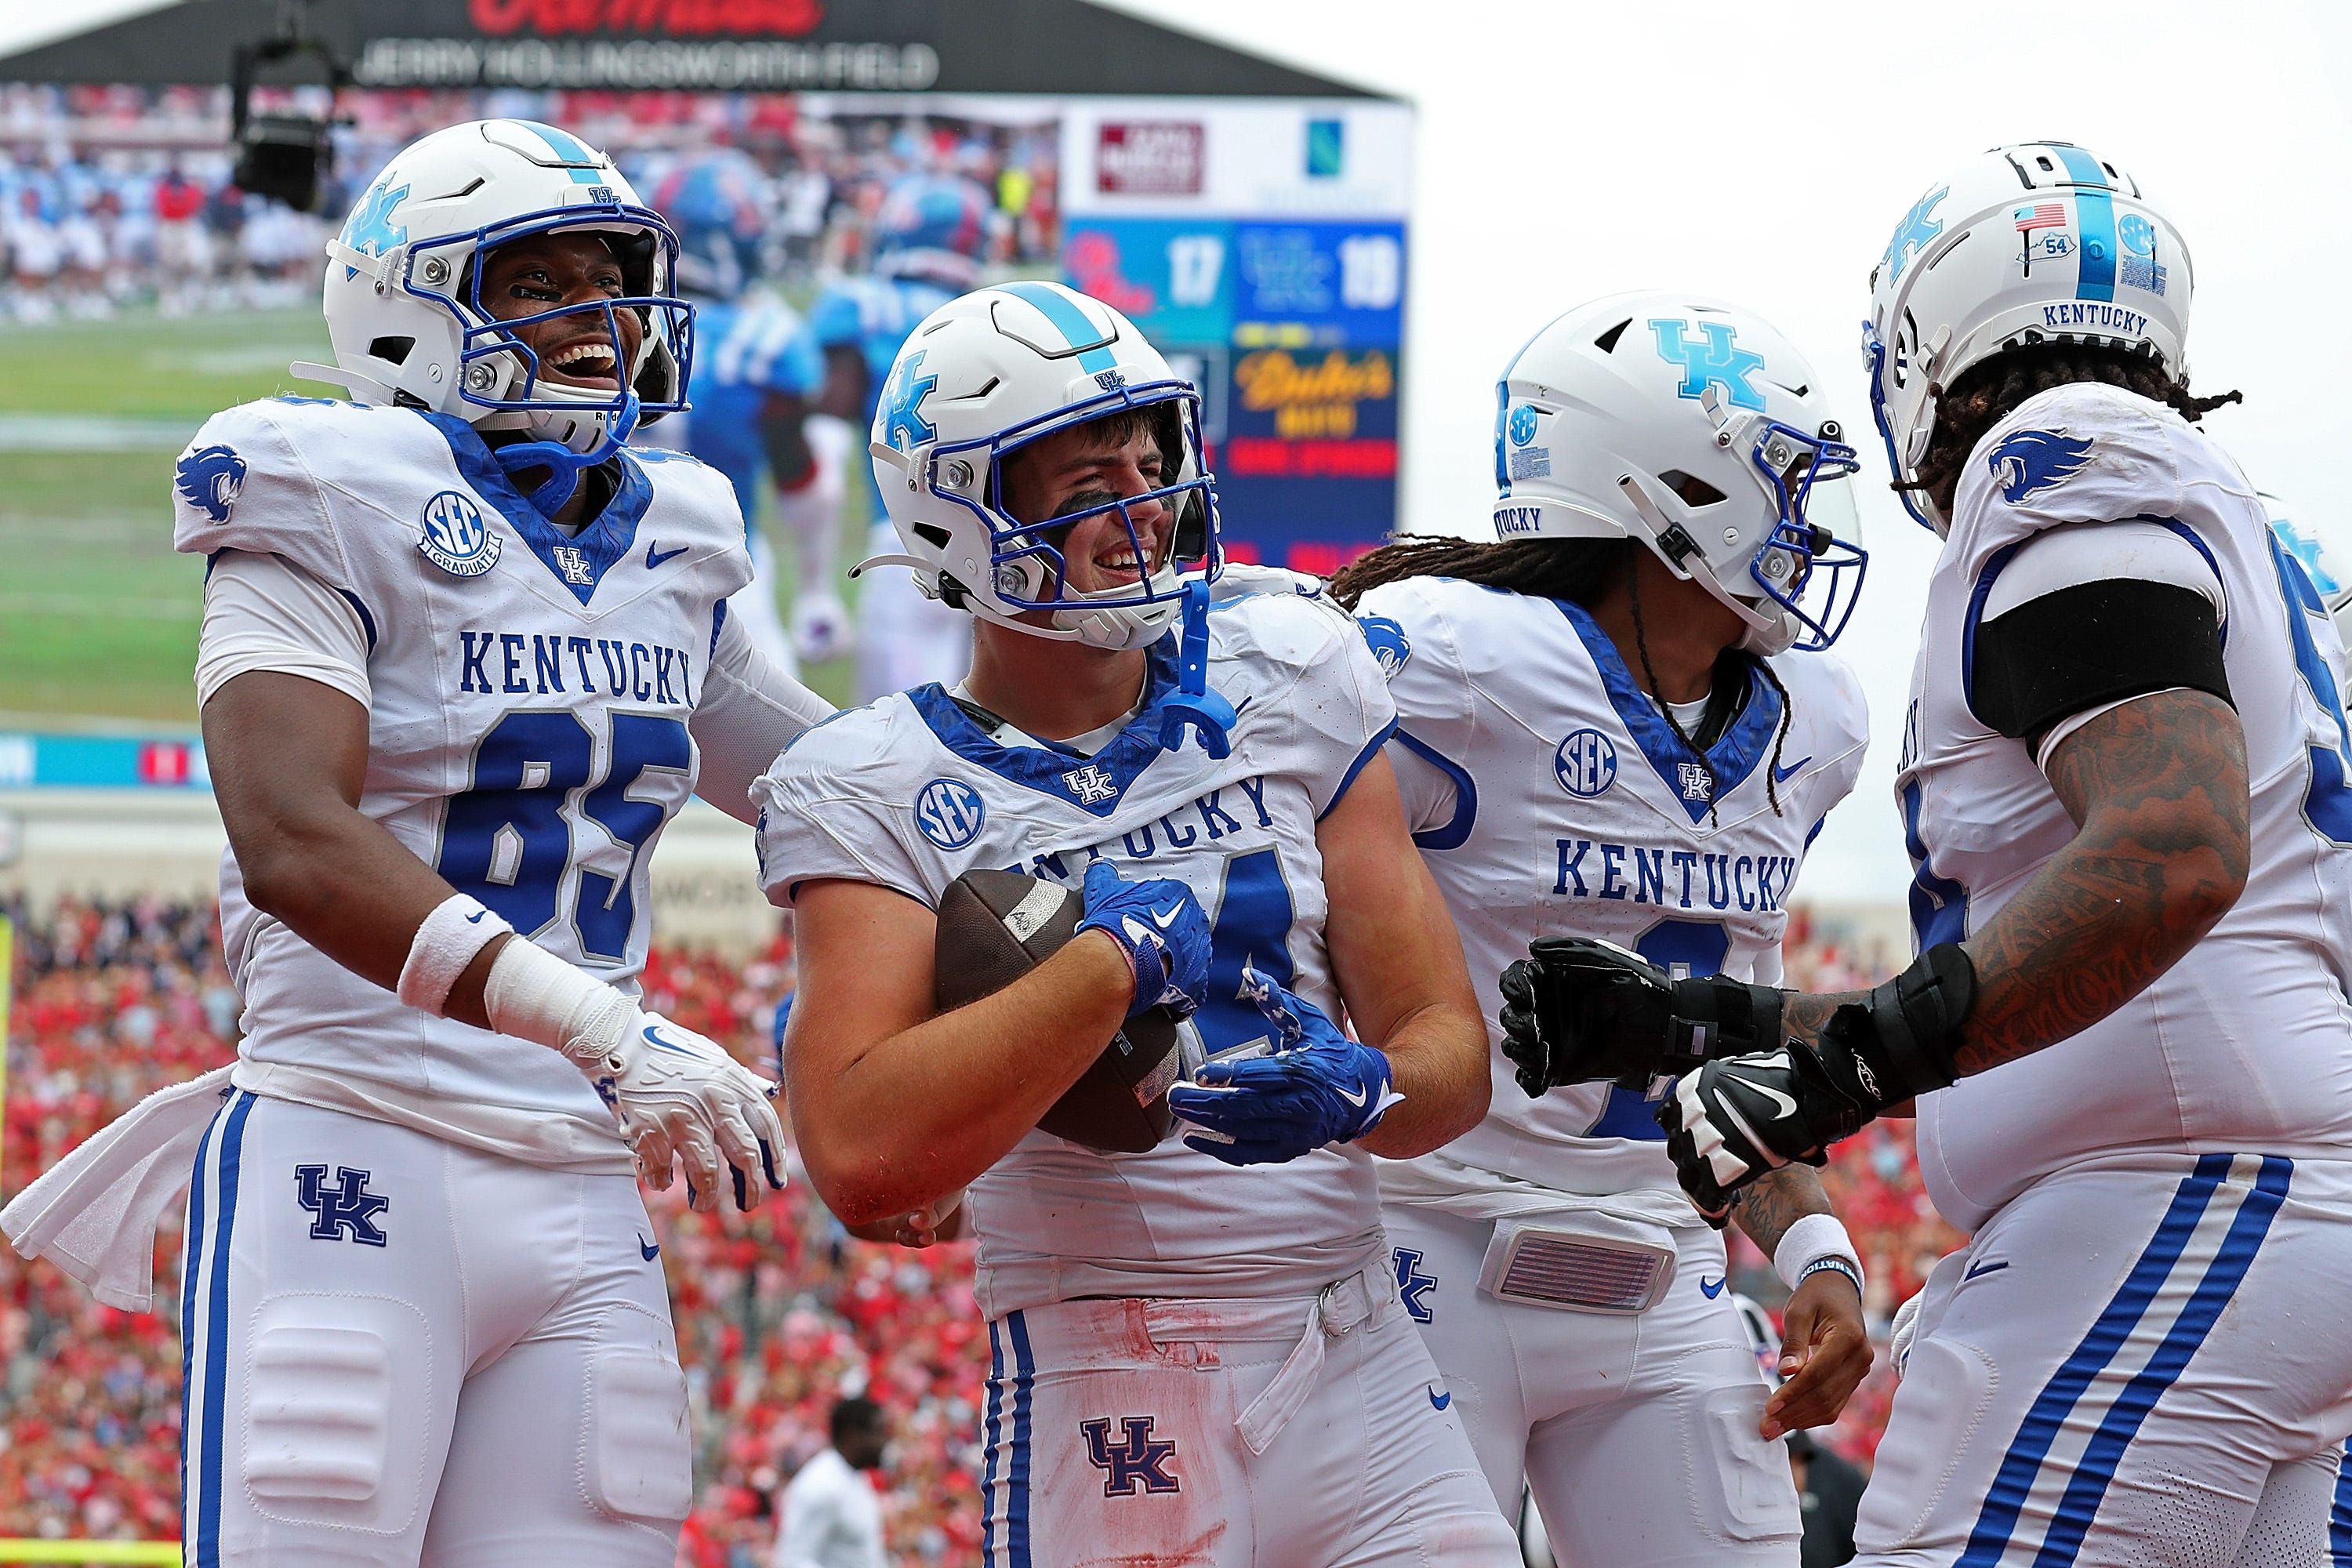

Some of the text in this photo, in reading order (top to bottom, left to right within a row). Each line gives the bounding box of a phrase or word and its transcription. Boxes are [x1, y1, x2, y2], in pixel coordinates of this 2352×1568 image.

[355, 38, 477, 87] JERRY
[823, 42, 940, 91] FIELD
[1169, 234, 1225, 306] 17
[2045, 238, 2067, 254] 54
[2043, 304, 2147, 336] KENTUCKY
[1648, 318, 1766, 413] UK
[426, 494, 483, 554] SEC
[1494, 507, 1541, 542] TUCKY
[433, 548, 497, 574] GRADUATE
[553, 546, 593, 585] UK
[459, 632, 695, 710] KENTUCKY
[1062, 765, 1118, 806] UK
[1559, 731, 1614, 792] SEC
[1677, 763, 1715, 802] UK
[433, 707, 693, 964] 85
[920, 782, 978, 845] SEC
[1552, 839, 1795, 912] KENTUCKY
[295, 1163, 390, 1247] UK
[1800, 1259, 1845, 1281] NATION
[1080, 1416, 1181, 1497] UK
